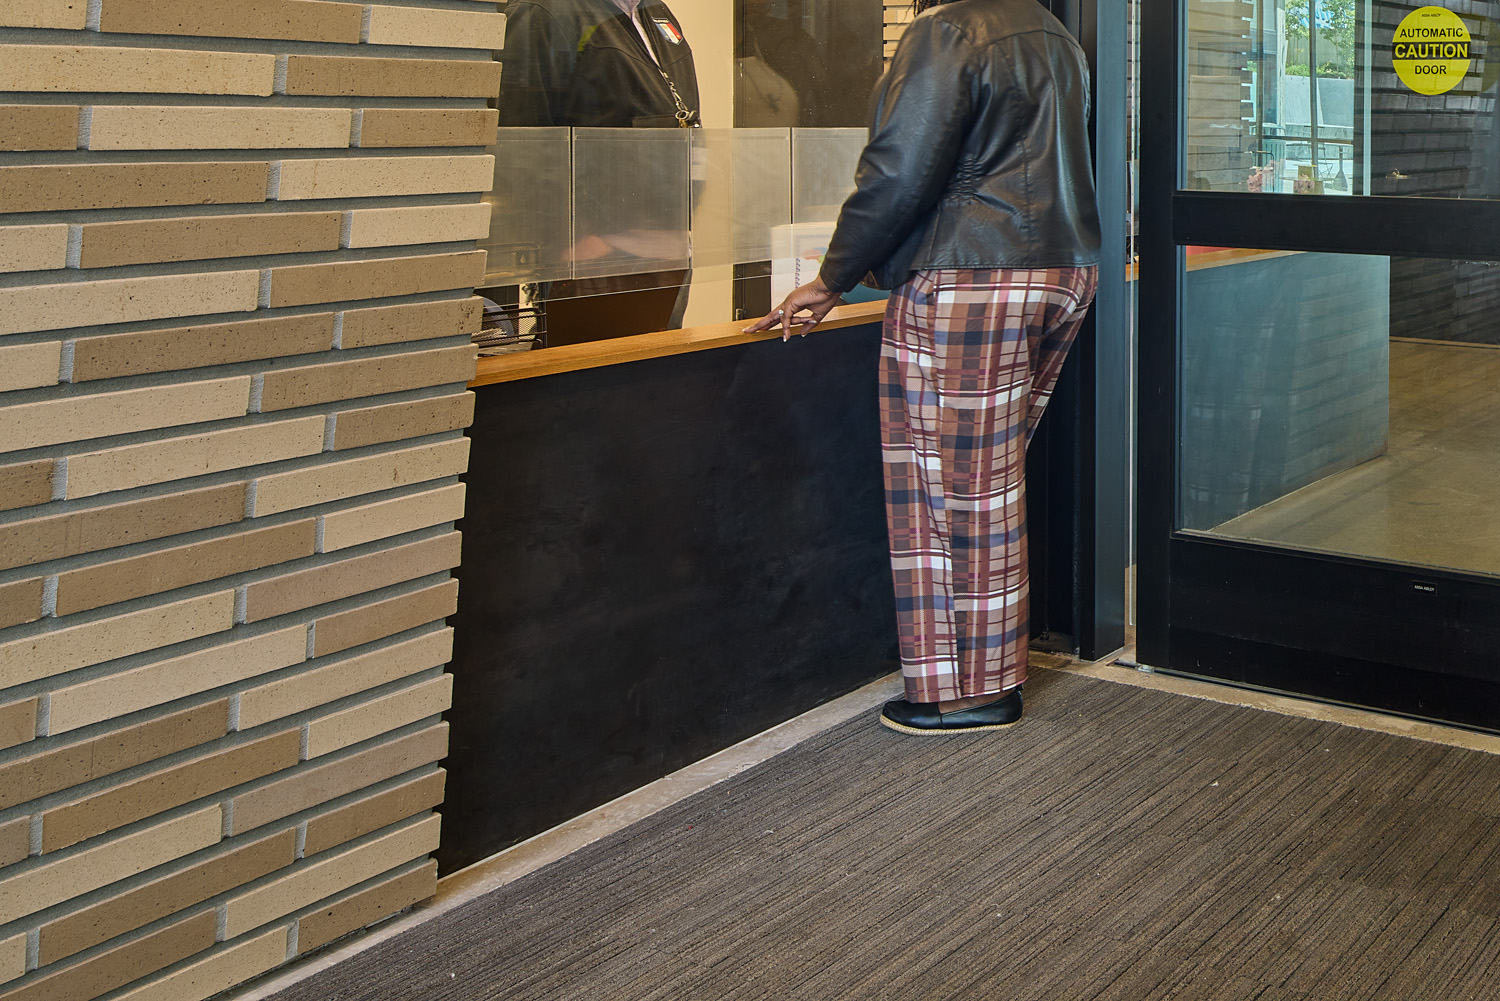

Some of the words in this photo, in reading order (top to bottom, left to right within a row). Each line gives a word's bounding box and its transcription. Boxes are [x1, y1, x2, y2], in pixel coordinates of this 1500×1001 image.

[1400, 28, 1463, 38] AUTOMATIC
[1394, 43, 1468, 58] CAUTION
[1414, 65, 1447, 75] DOOR
